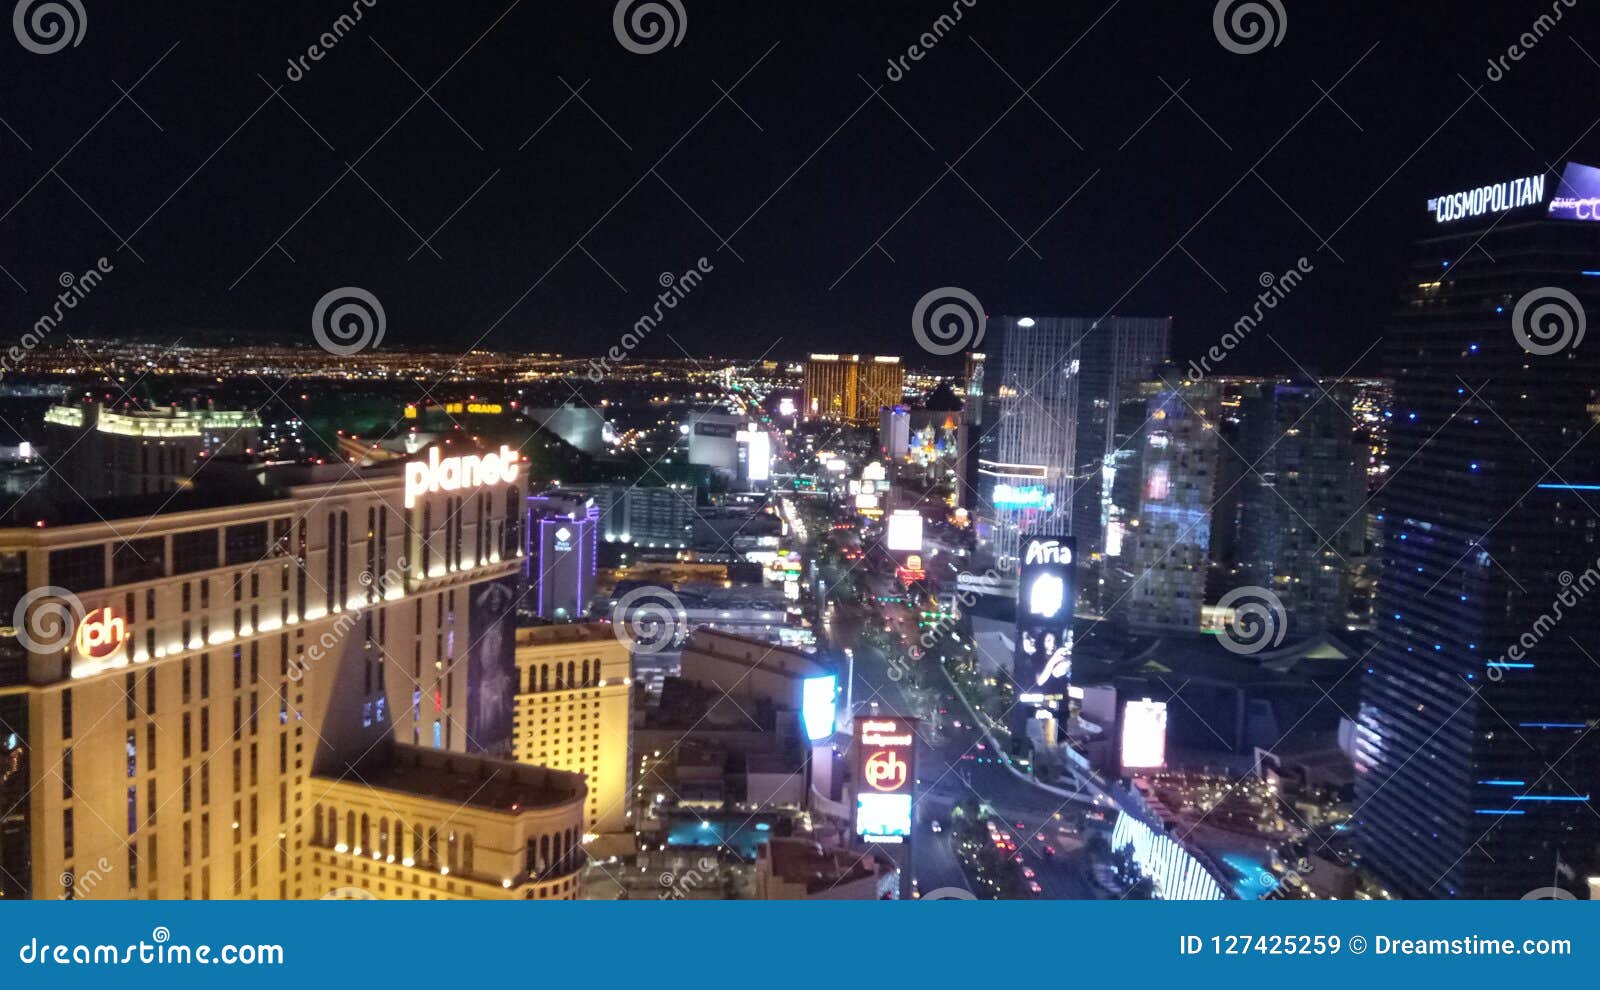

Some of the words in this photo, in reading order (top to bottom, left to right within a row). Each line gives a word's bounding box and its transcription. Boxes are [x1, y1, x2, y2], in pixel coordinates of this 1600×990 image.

[1437, 173, 1546, 222] COSMOPOLITAN
[404, 444, 520, 509] planet
[78, 607, 126, 659] ph
[866, 751, 907, 789] ph
